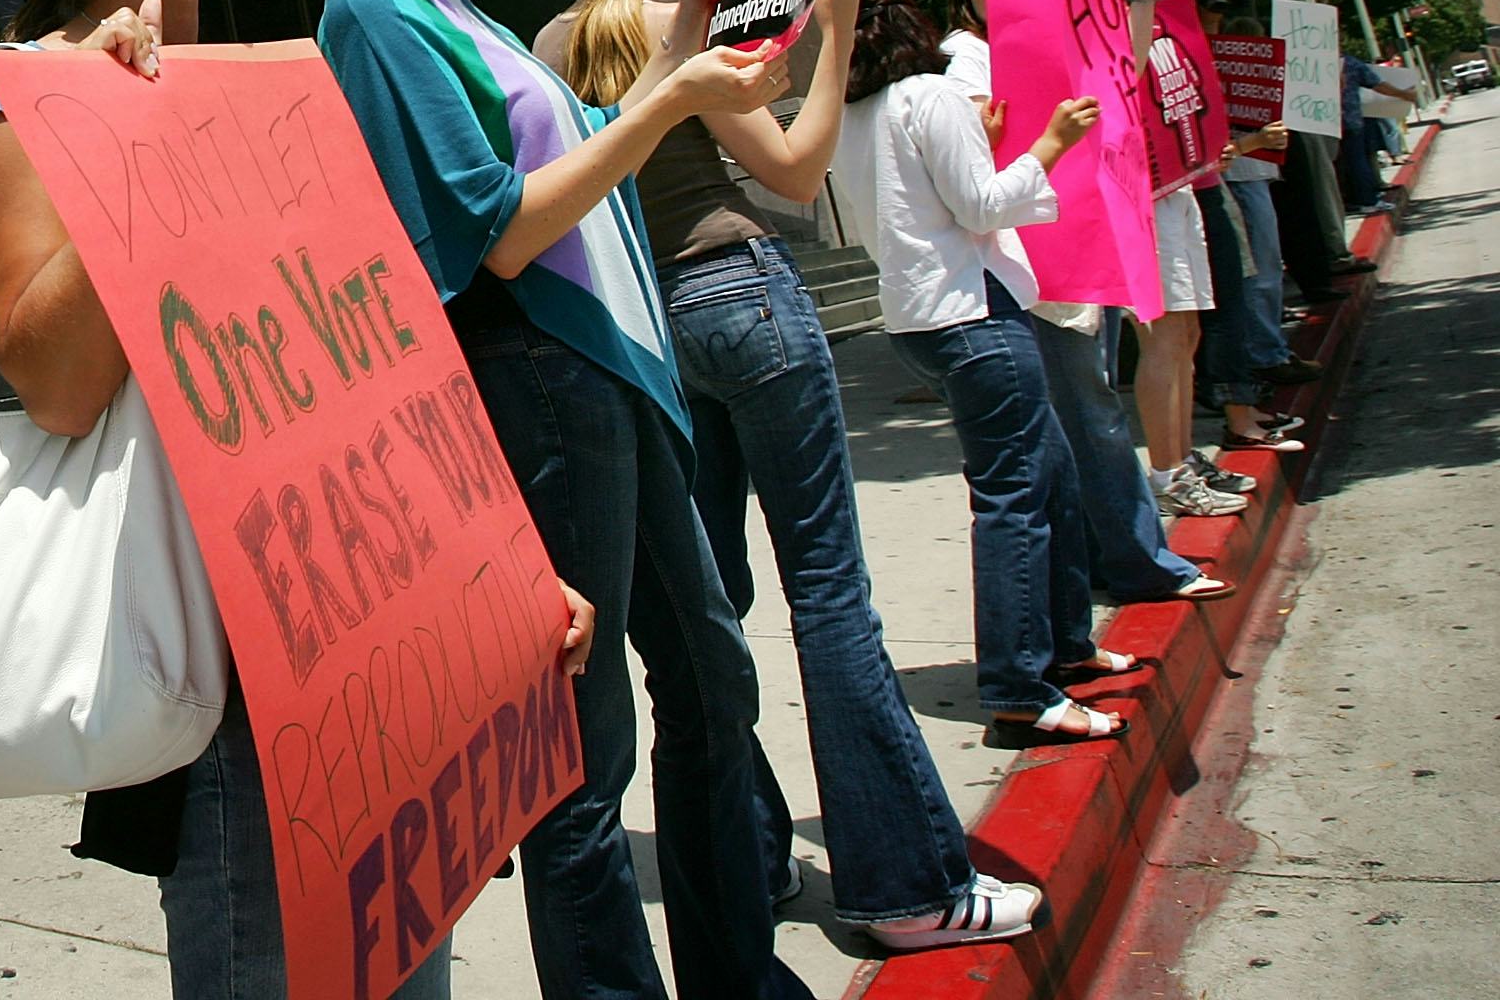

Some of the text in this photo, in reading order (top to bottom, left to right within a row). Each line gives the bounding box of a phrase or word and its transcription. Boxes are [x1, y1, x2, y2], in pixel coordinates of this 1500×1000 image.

[1148, 38, 1181, 76] MY
[1212, 60, 1285, 81] PRODUCTIVOS
[1159, 68, 1188, 93] BODY
[1231, 82, 1282, 102] DERECHOS
[1162, 82, 1198, 108] is not
[1163, 96, 1203, 124] PUBLIC
[1228, 102, 1272, 122] UMANOS!
[219, 83, 337, 219] LET
[234, 370, 519, 690] ERASE YOUR
[272, 523, 563, 897] REPRODUCTIVE
[348, 663, 578, 1000] FREEDOM
